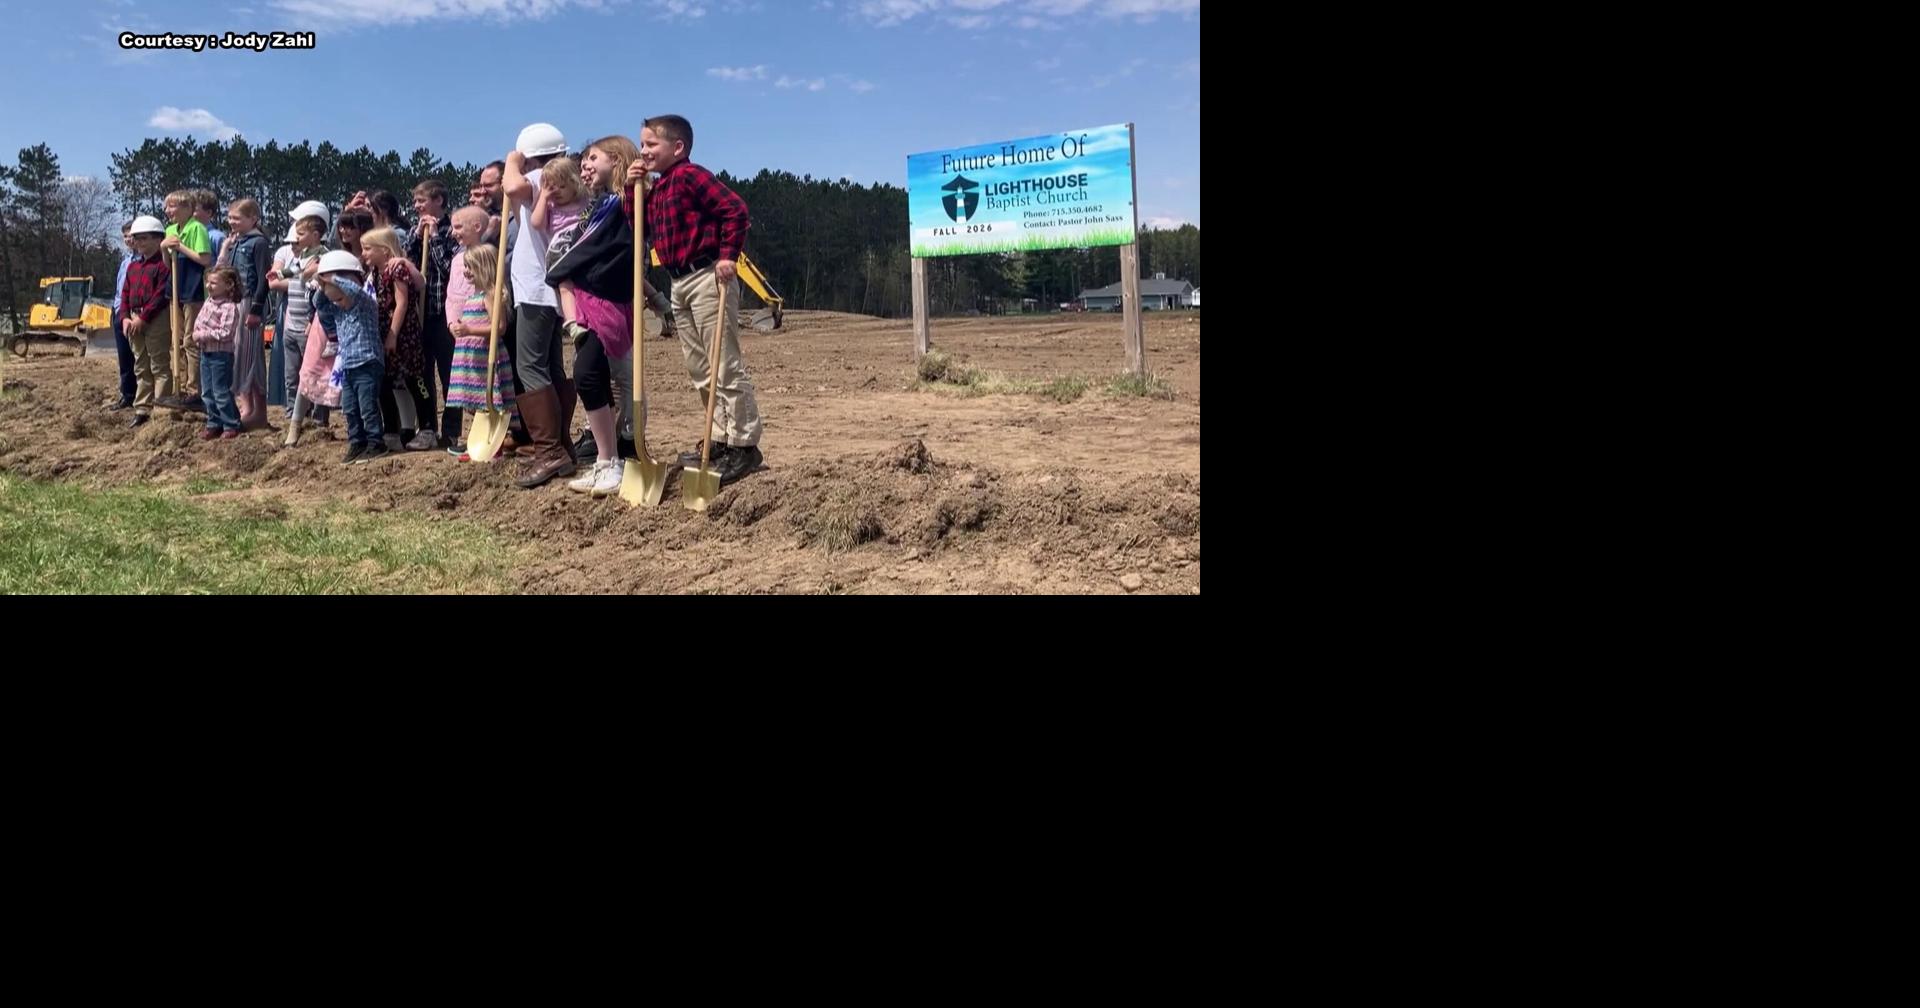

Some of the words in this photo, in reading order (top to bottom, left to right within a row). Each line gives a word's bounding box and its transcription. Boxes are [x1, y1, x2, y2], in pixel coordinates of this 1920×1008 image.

[942, 153, 995, 174] Future
[1001, 145, 1055, 167] Home
[1061, 134, 1088, 159] Of
[985, 173, 1088, 197] LIGHTHOUSE
[986, 195, 1031, 211] Baptist
[1036, 188, 1088, 205] Church
[1023, 210, 1050, 219] Phone:
[1051, 205, 1103, 217] 715.350.4682
[933, 227, 957, 236] FALL
[966, 223, 993, 234] 2026
[1023, 219, 1056, 229] Contact:
[1058, 218, 1083, 227] Pastor
[1084, 216, 1104, 225] John
